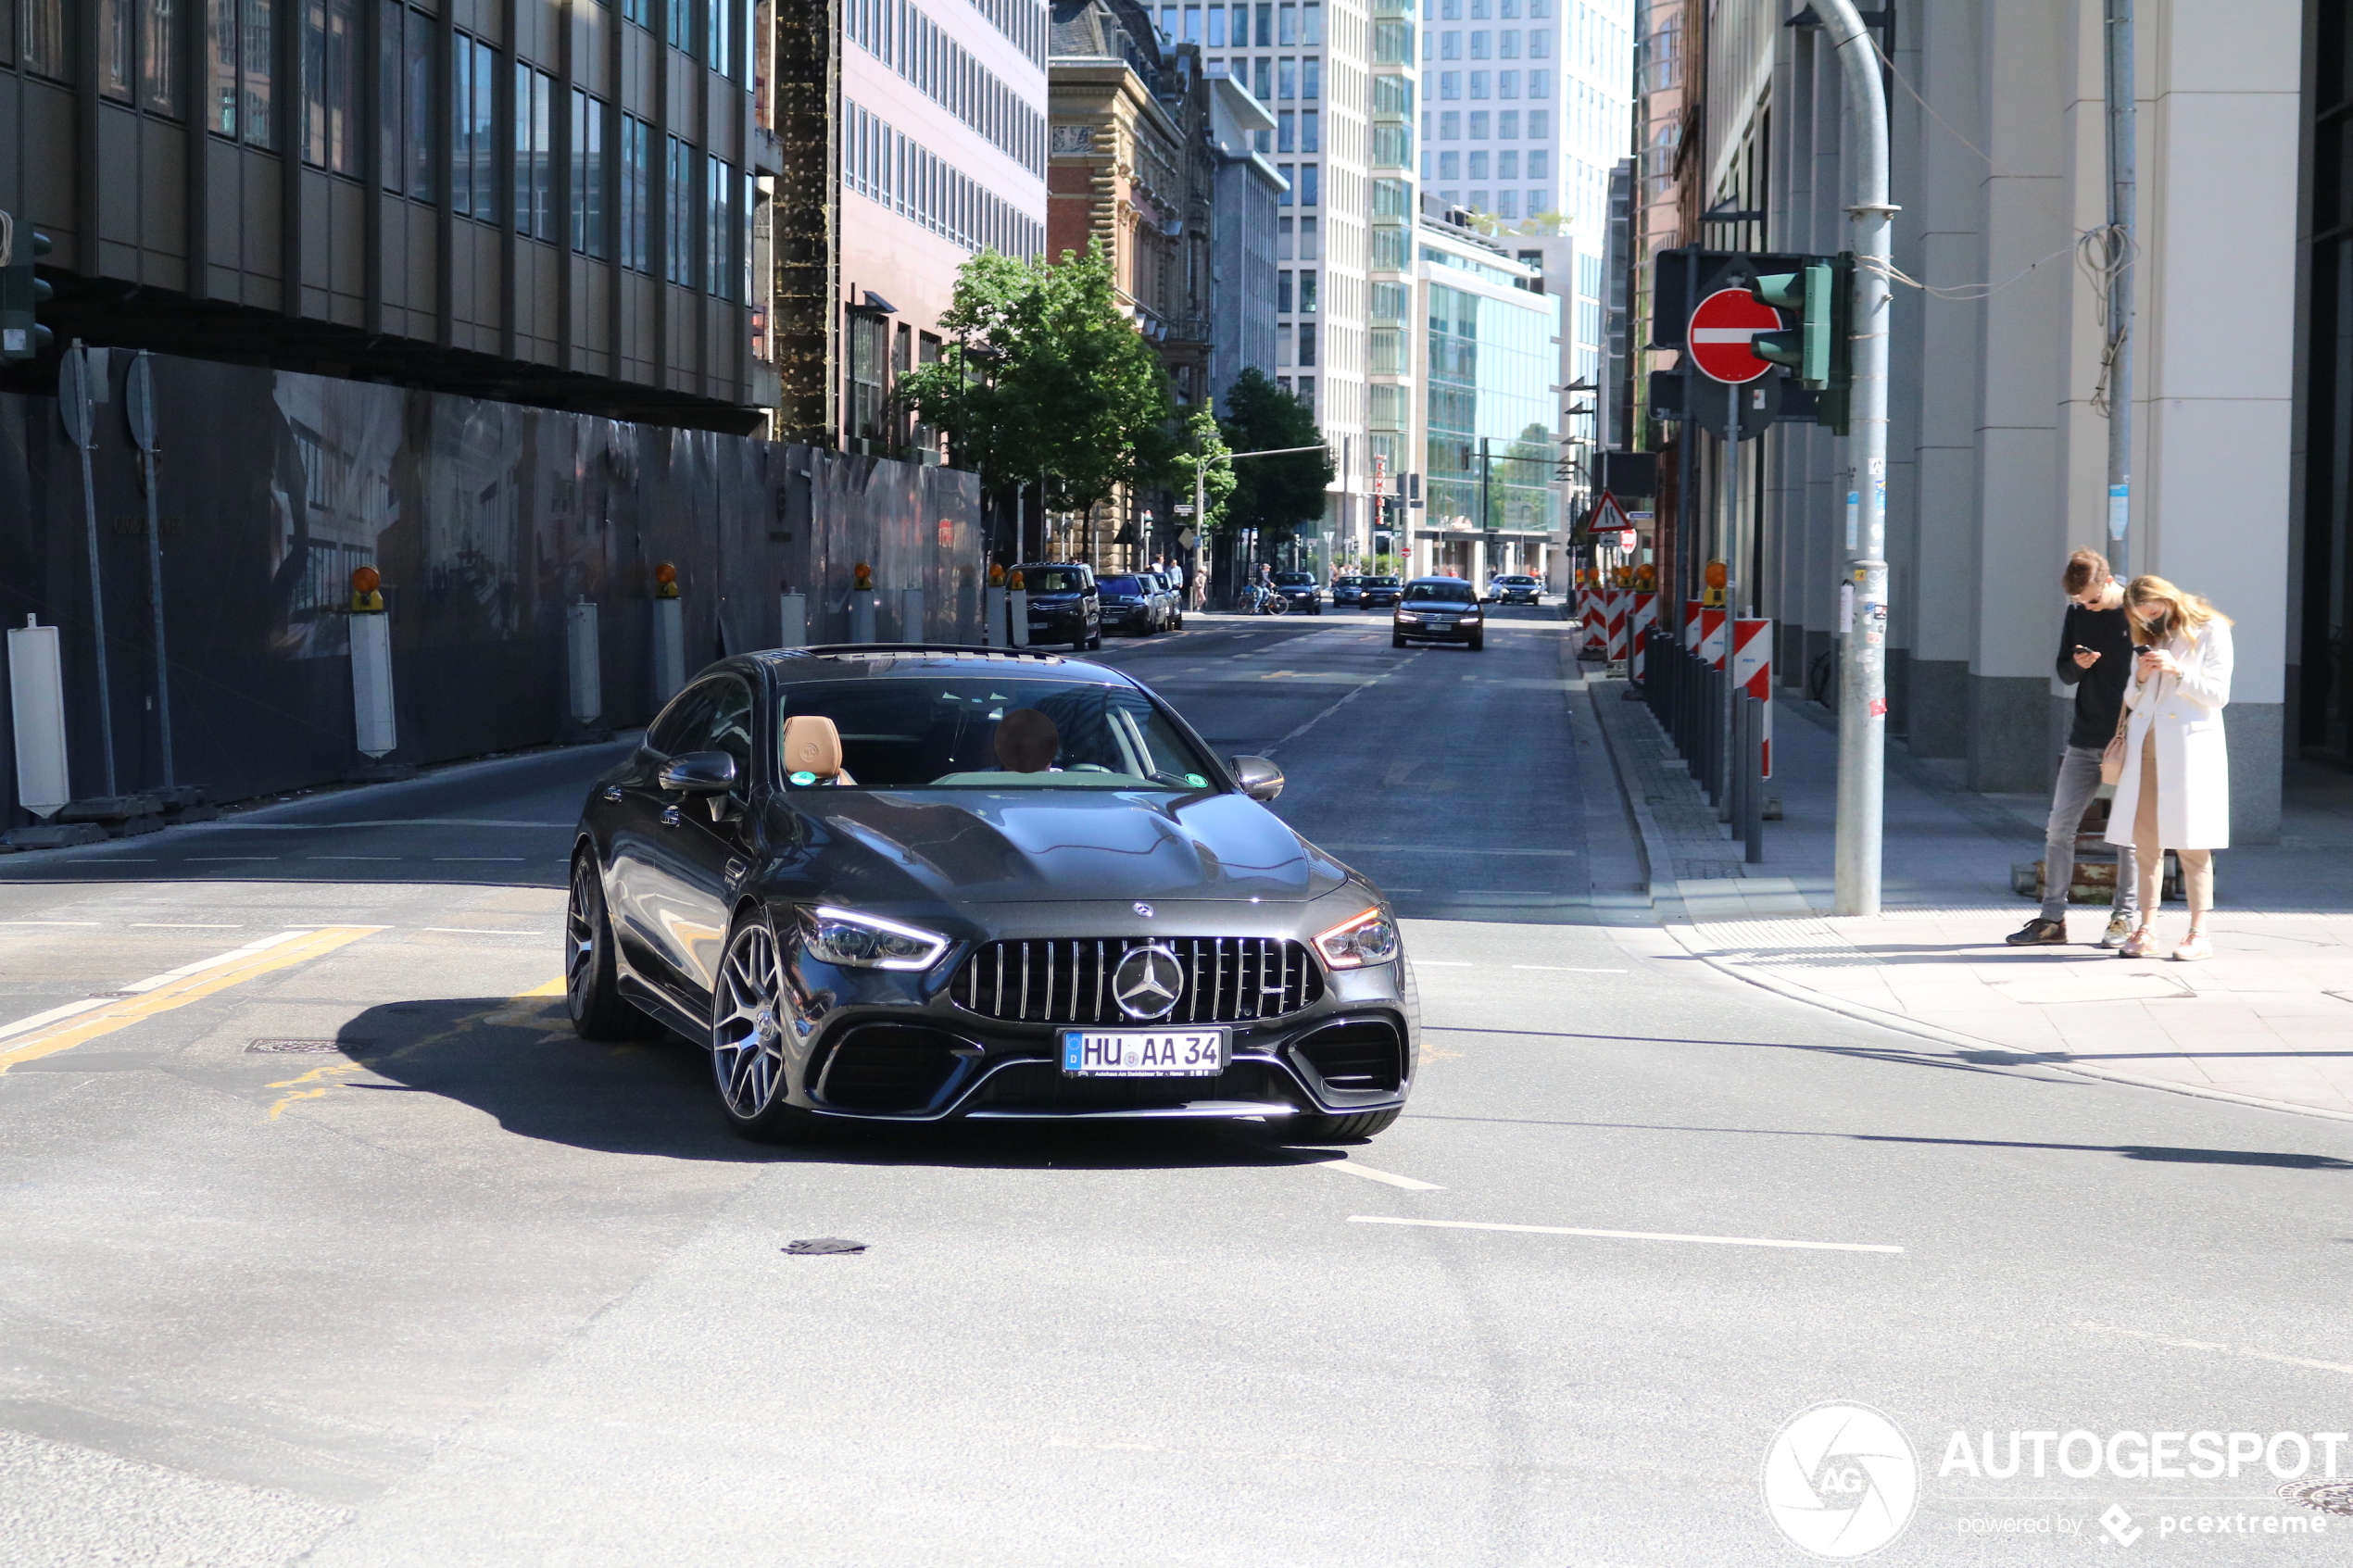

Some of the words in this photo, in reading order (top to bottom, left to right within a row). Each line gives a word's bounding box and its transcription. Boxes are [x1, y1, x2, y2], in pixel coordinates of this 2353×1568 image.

[1070, 1054, 1077, 1064] D
[1084, 1037, 1122, 1066] HU
[1140, 1037, 1176, 1065] AA
[1184, 1036, 1217, 1065] 34
